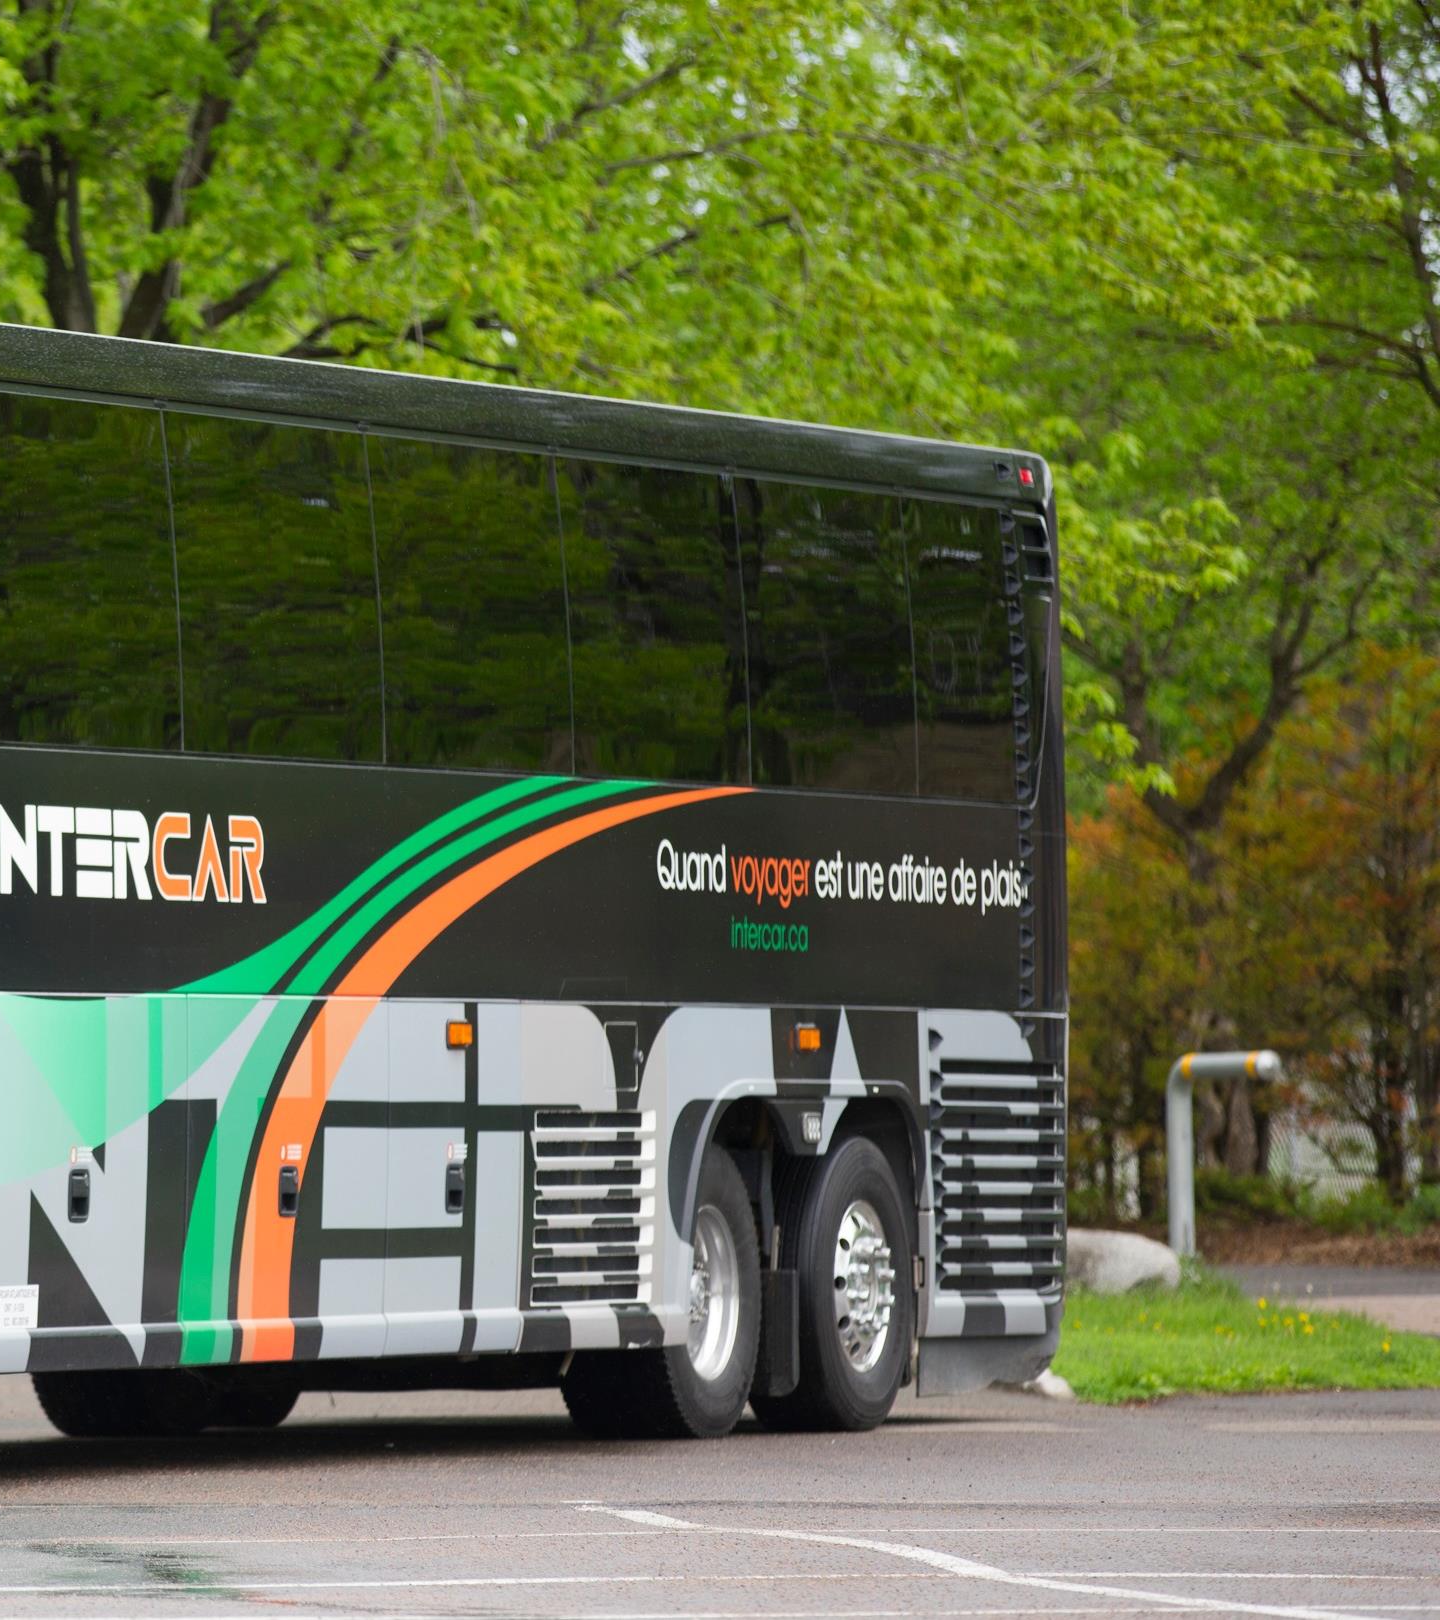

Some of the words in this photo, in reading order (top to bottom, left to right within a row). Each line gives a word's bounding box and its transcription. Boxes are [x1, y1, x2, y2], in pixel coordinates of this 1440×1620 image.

[657, 838, 727, 894] Quand
[731, 855, 810, 909] voyager
[814, 850, 843, 899] est
[847, 861, 885, 901] une
[888, 854, 947, 905] affaire
[951, 858, 977, 906] de
[730, 914, 809, 952] intercar.ca
